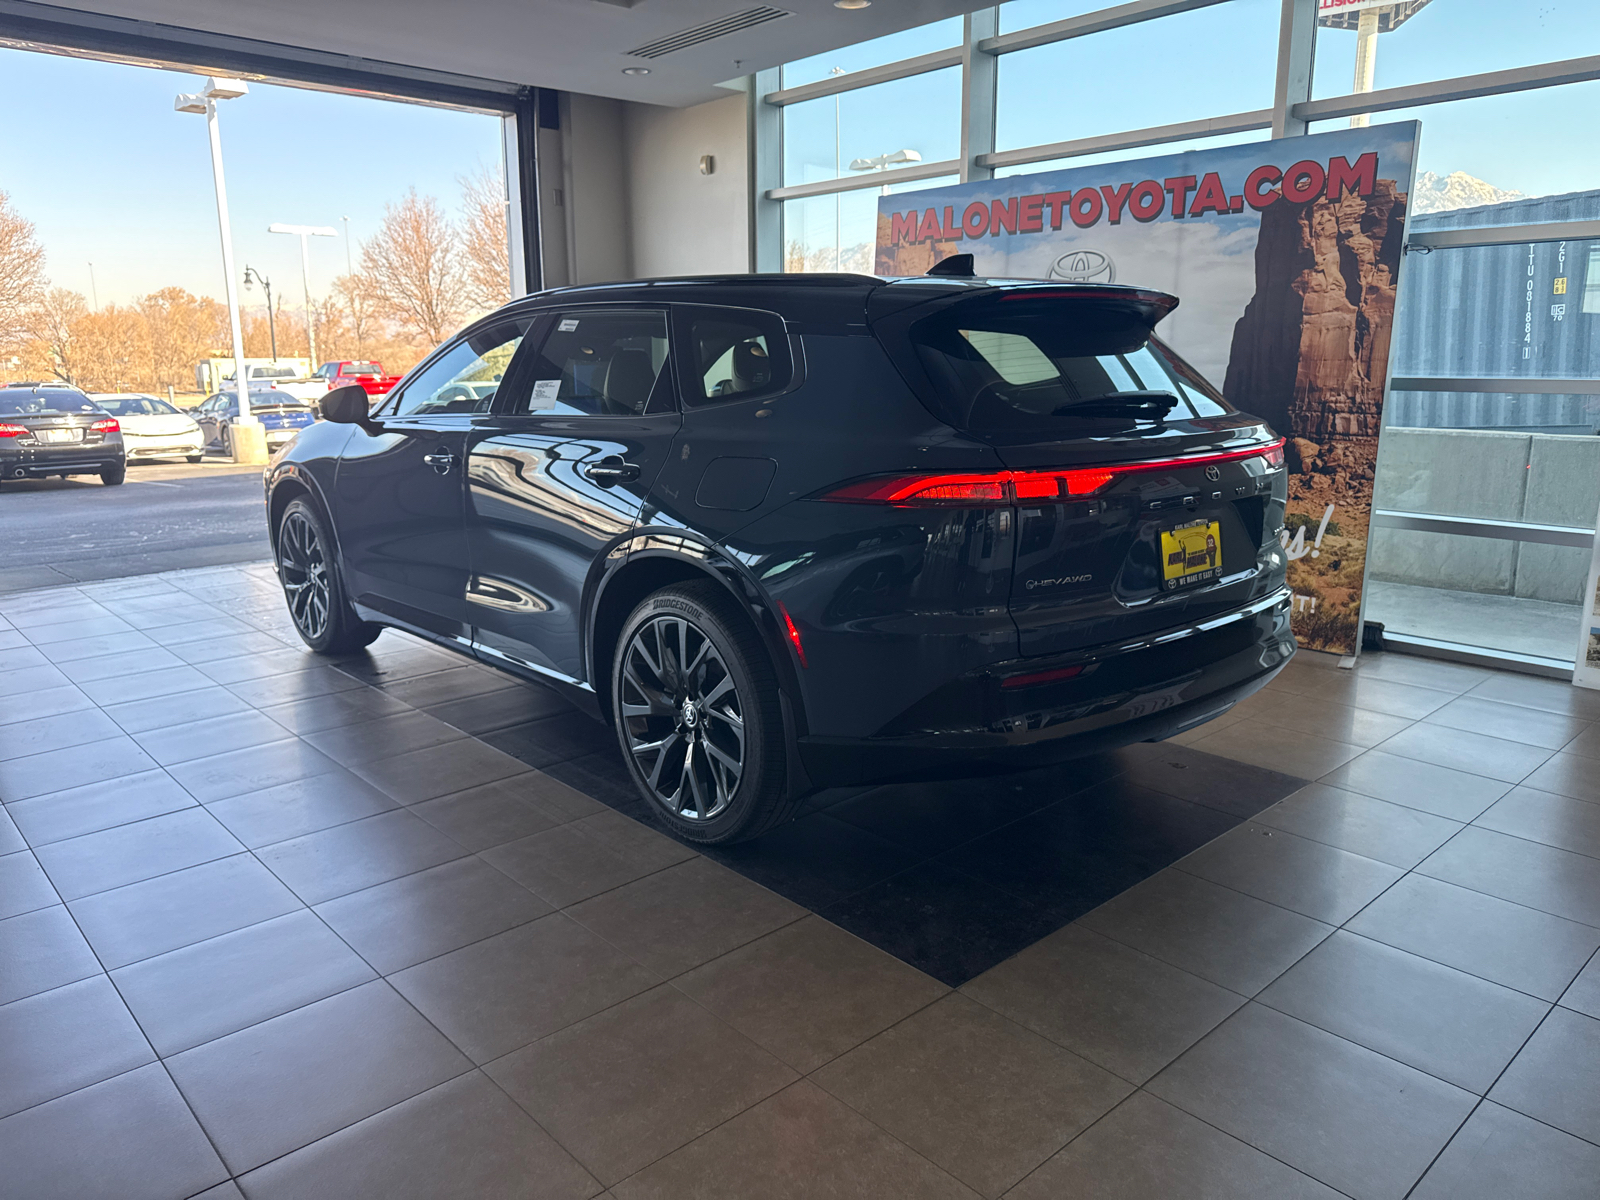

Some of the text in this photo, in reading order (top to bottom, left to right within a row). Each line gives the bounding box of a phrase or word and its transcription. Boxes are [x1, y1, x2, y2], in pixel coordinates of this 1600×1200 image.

[891, 152, 1379, 246] MALONETOYOTA.COM
[1524, 280, 1533, 344] 081884
[1207, 538, 1214, 547] 32
[653, 598, 704, 621] BRIDGESTONE
